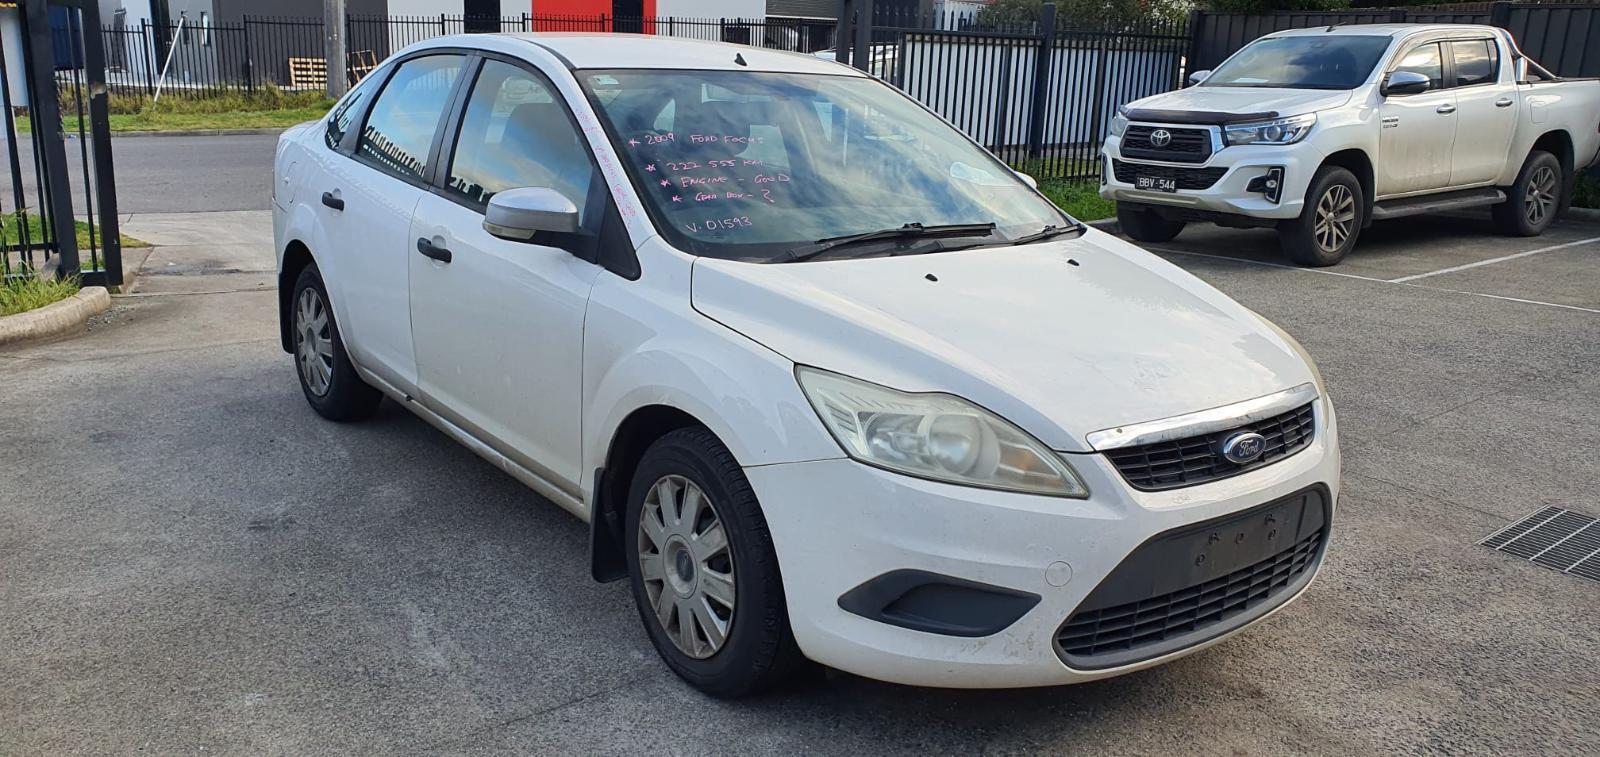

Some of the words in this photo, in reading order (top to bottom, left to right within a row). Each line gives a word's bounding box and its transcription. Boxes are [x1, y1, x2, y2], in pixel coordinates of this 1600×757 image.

[645, 133, 674, 146] 2009
[690, 134, 718, 143] FORD
[666, 161, 701, 171] 222
[681, 176, 728, 188] ENGINE
[754, 174, 790, 183] GOOD
[1239, 440, 1259, 456] Ford
